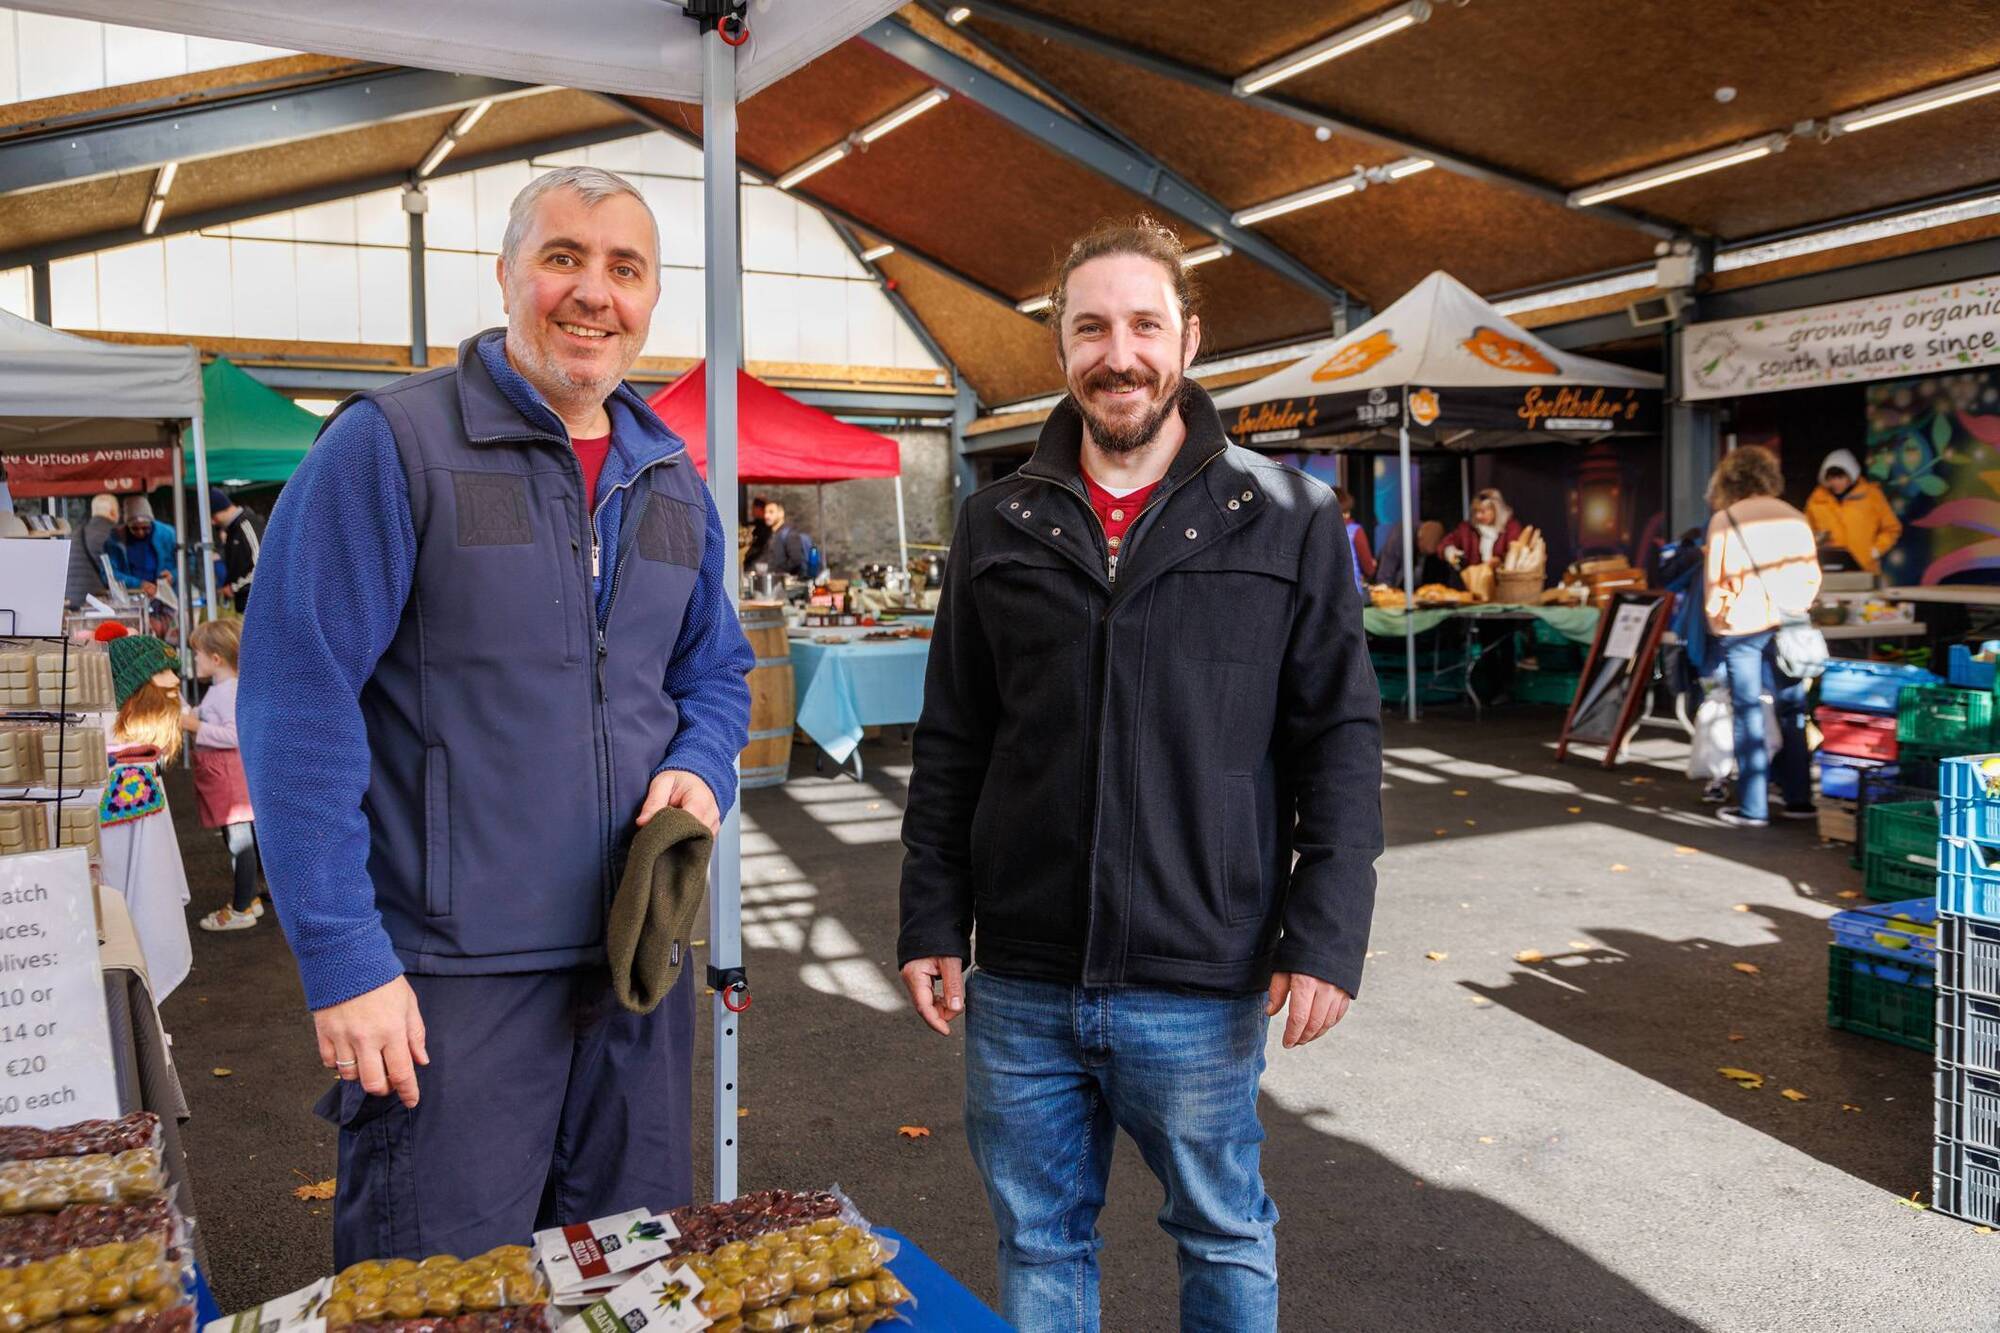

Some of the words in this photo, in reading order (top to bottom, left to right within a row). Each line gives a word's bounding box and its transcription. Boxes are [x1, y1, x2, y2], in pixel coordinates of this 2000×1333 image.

[1786, 316, 1893, 352] growing
[1757, 352, 1820, 379] south
[1826, 342, 1916, 367] kildare
[1927, 331, 1997, 357] since
[25, 453, 90, 467] Options
[94, 448, 165, 462] Available
[0, 953, 58, 973] lives:
[31, 987, 54, 1003] or
[34, 1022, 57, 1038] or
[6, 1055, 46, 1077] €20
[26, 1084, 76, 1110] each
